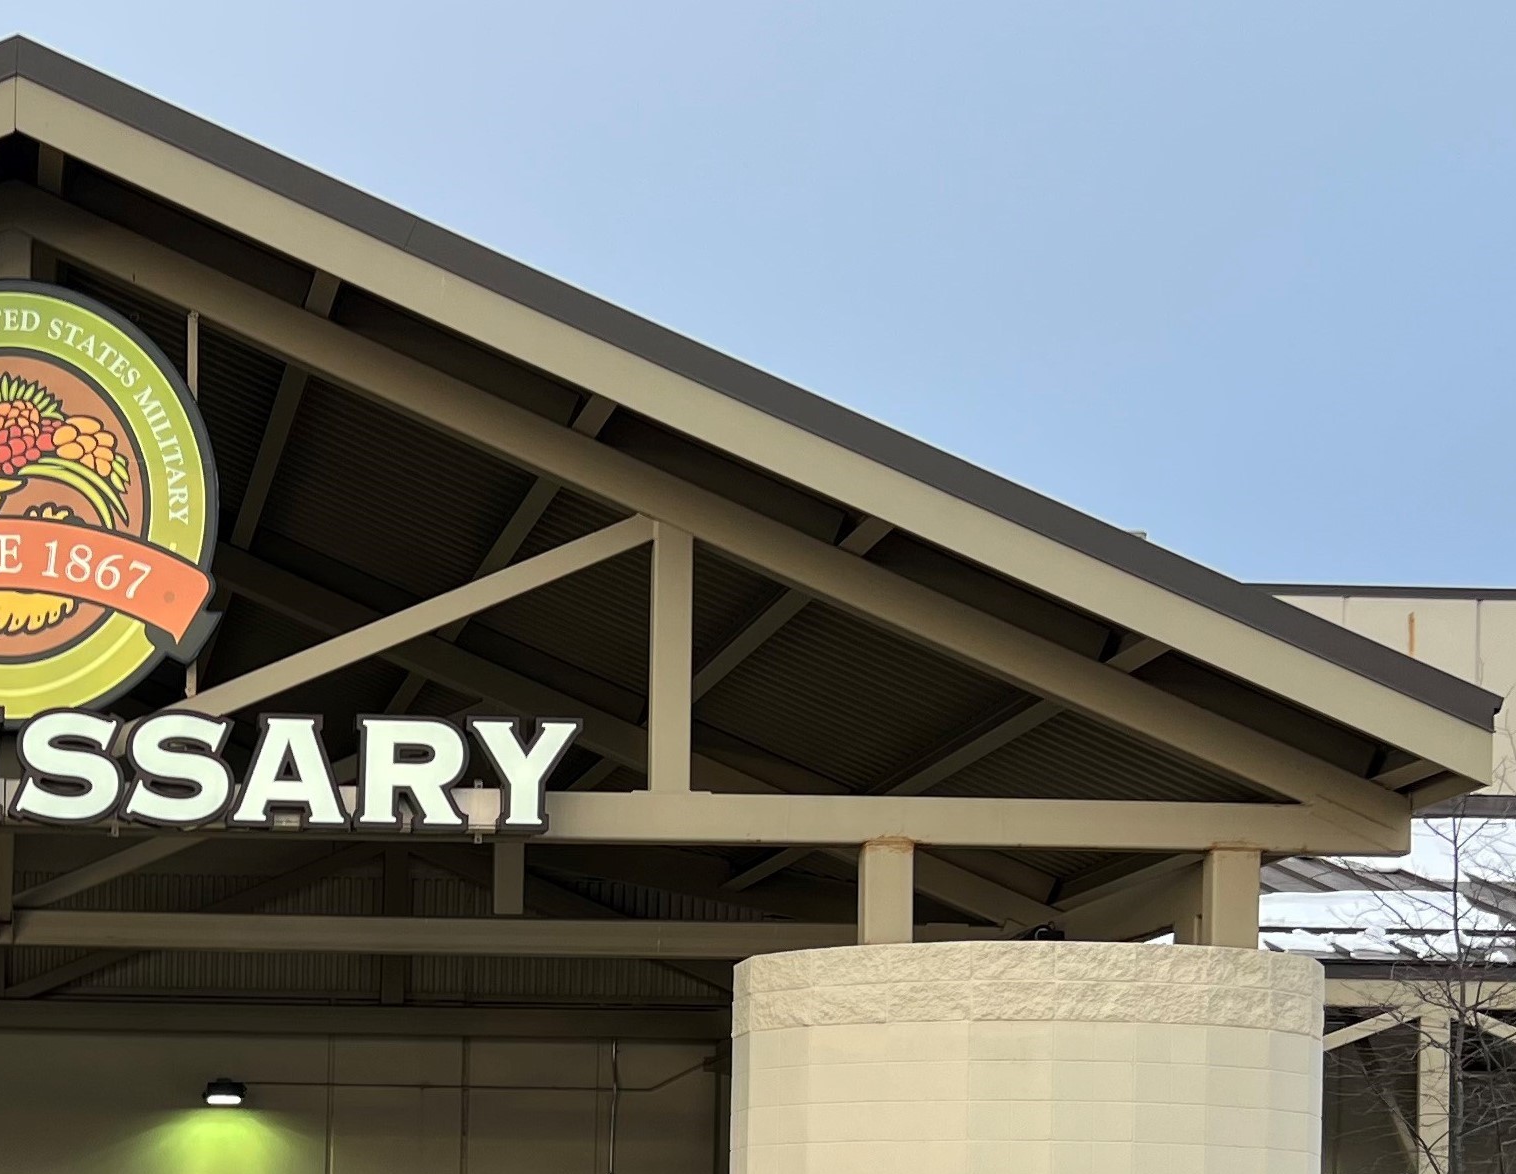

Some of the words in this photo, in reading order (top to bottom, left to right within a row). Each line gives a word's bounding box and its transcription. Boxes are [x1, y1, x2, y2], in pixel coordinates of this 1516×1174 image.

[47, 318, 141, 388] STATES
[134, 389, 189, 527] MILITARY
[42, 539, 152, 600] 1867
